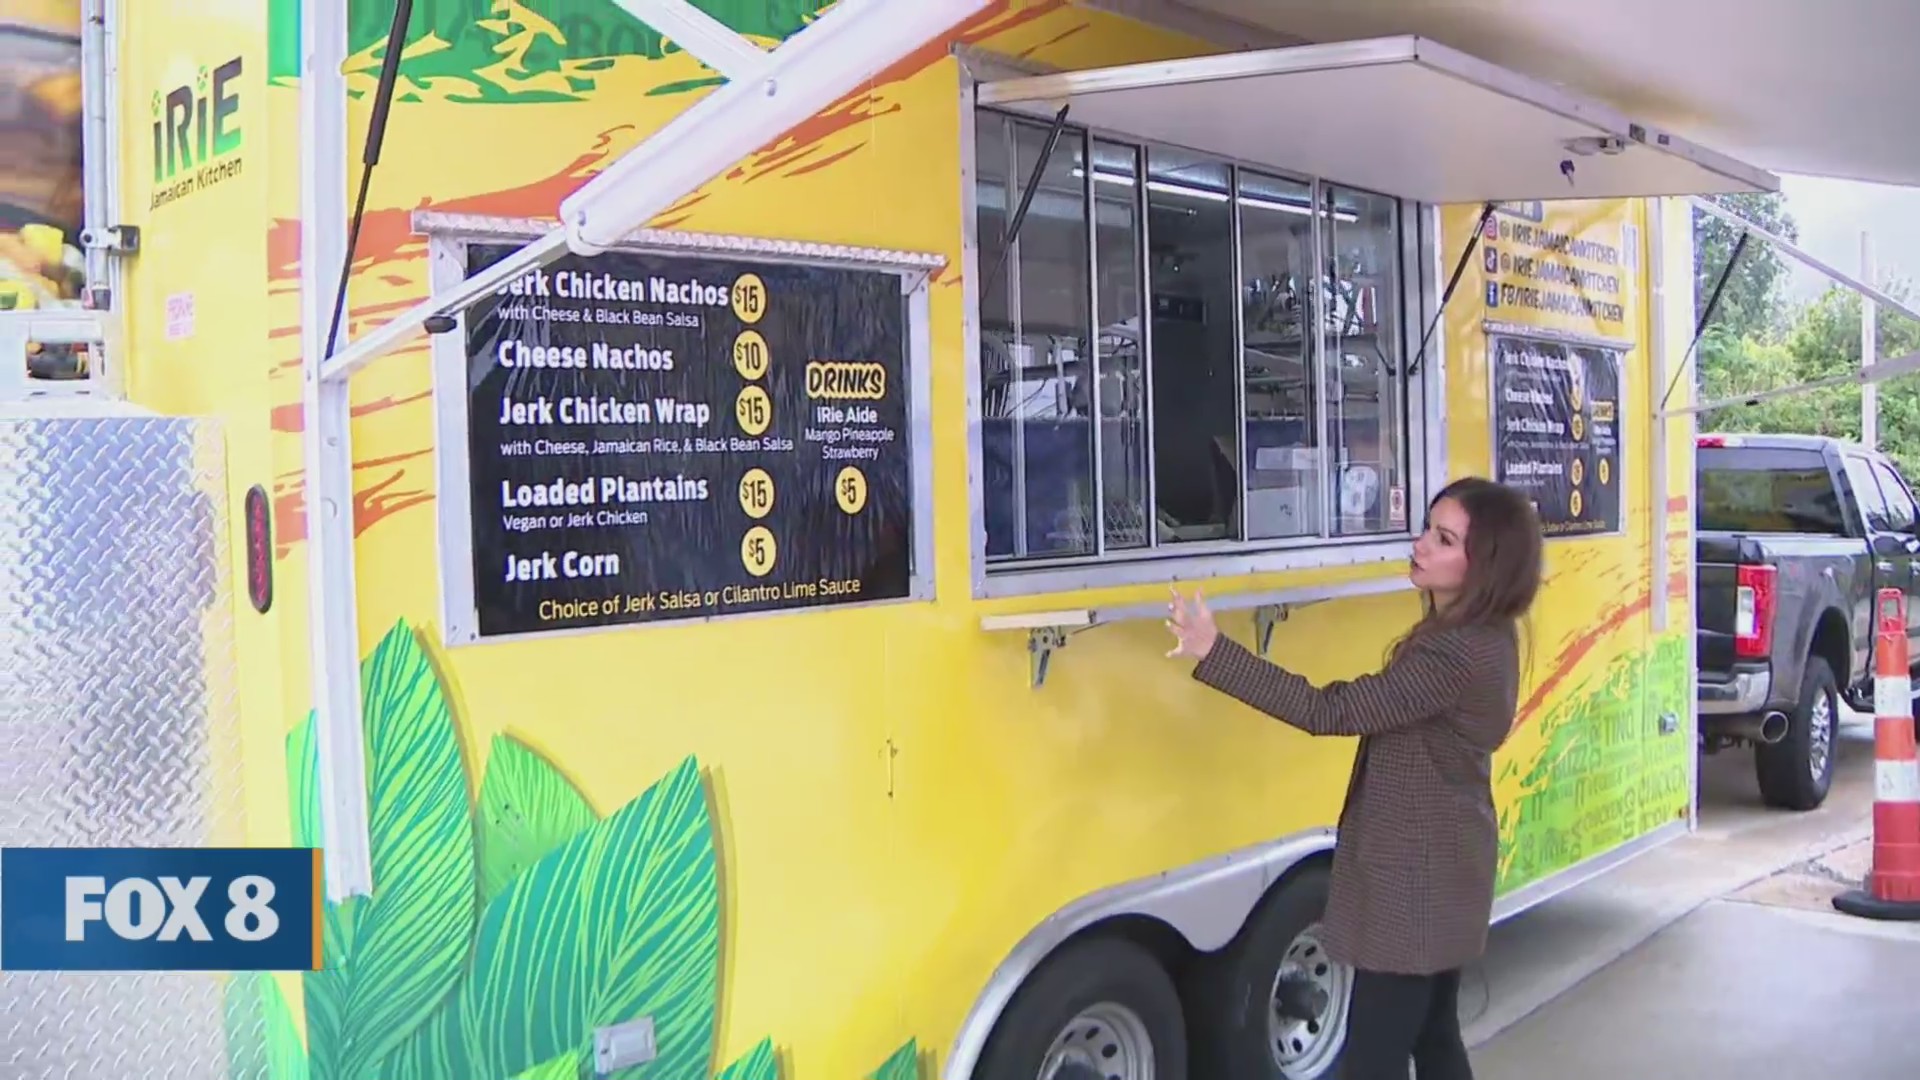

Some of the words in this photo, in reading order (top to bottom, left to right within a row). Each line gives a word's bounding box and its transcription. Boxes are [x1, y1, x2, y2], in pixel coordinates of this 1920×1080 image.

[149, 178, 193, 211] Jamaican
[197, 157, 242, 190] Kitchen
[555, 271, 644, 301] Chicken
[650, 276, 729, 306] Nachos
[735, 285, 759, 314] $15
[498, 305, 528, 320] with
[532, 306, 580, 322] Cheese
[583, 308, 593, 323] &
[596, 309, 630, 324] Black
[633, 310, 663, 325] Bean
[666, 312, 699, 327] Salsa
[499, 341, 588, 369] Cheese
[593, 343, 674, 371] Nachos
[736, 341, 762, 371] $10
[808, 367, 883, 394] DRINKS
[500, 396, 554, 425] Jerk
[559, 396, 651, 426] Chicken
[655, 399, 710, 428] Wrap
[739, 397, 764, 426] $15
[846, 406, 878, 424] Aide
[501, 439, 532, 455] with
[535, 440, 589, 456] Cheese,
[592, 439, 651, 454] Jamaican
[654, 439, 682, 454] Rice,
[683, 439, 693, 453] &
[696, 438, 727, 452] Black
[730, 438, 760, 451] Bean
[763, 437, 794, 451] Salsa
[805, 428, 841, 444] Mango
[843, 428, 895, 442] Pineapple
[822, 445, 880, 461] Strawberry
[502, 477, 594, 507] Loaded
[601, 475, 709, 504] Plantains
[742, 479, 767, 508] $15
[841, 477, 857, 504] $5
[503, 514, 546, 532] Vegan
[550, 516, 563, 528] or
[567, 512, 594, 528] Jerk
[597, 511, 648, 526] Chicken
[748, 538, 766, 565] $5
[505, 552, 557, 582] Jerk
[563, 551, 619, 579] Corn
[539, 599, 598, 620] Choice
[602, 597, 621, 615] of
[623, 595, 655, 613] Jerk
[659, 592, 701, 609] Salsa
[705, 592, 720, 606] or
[722, 585, 780, 604] Cilantro
[783, 581, 815, 598] Lime
[820, 578, 861, 596] Sauce
